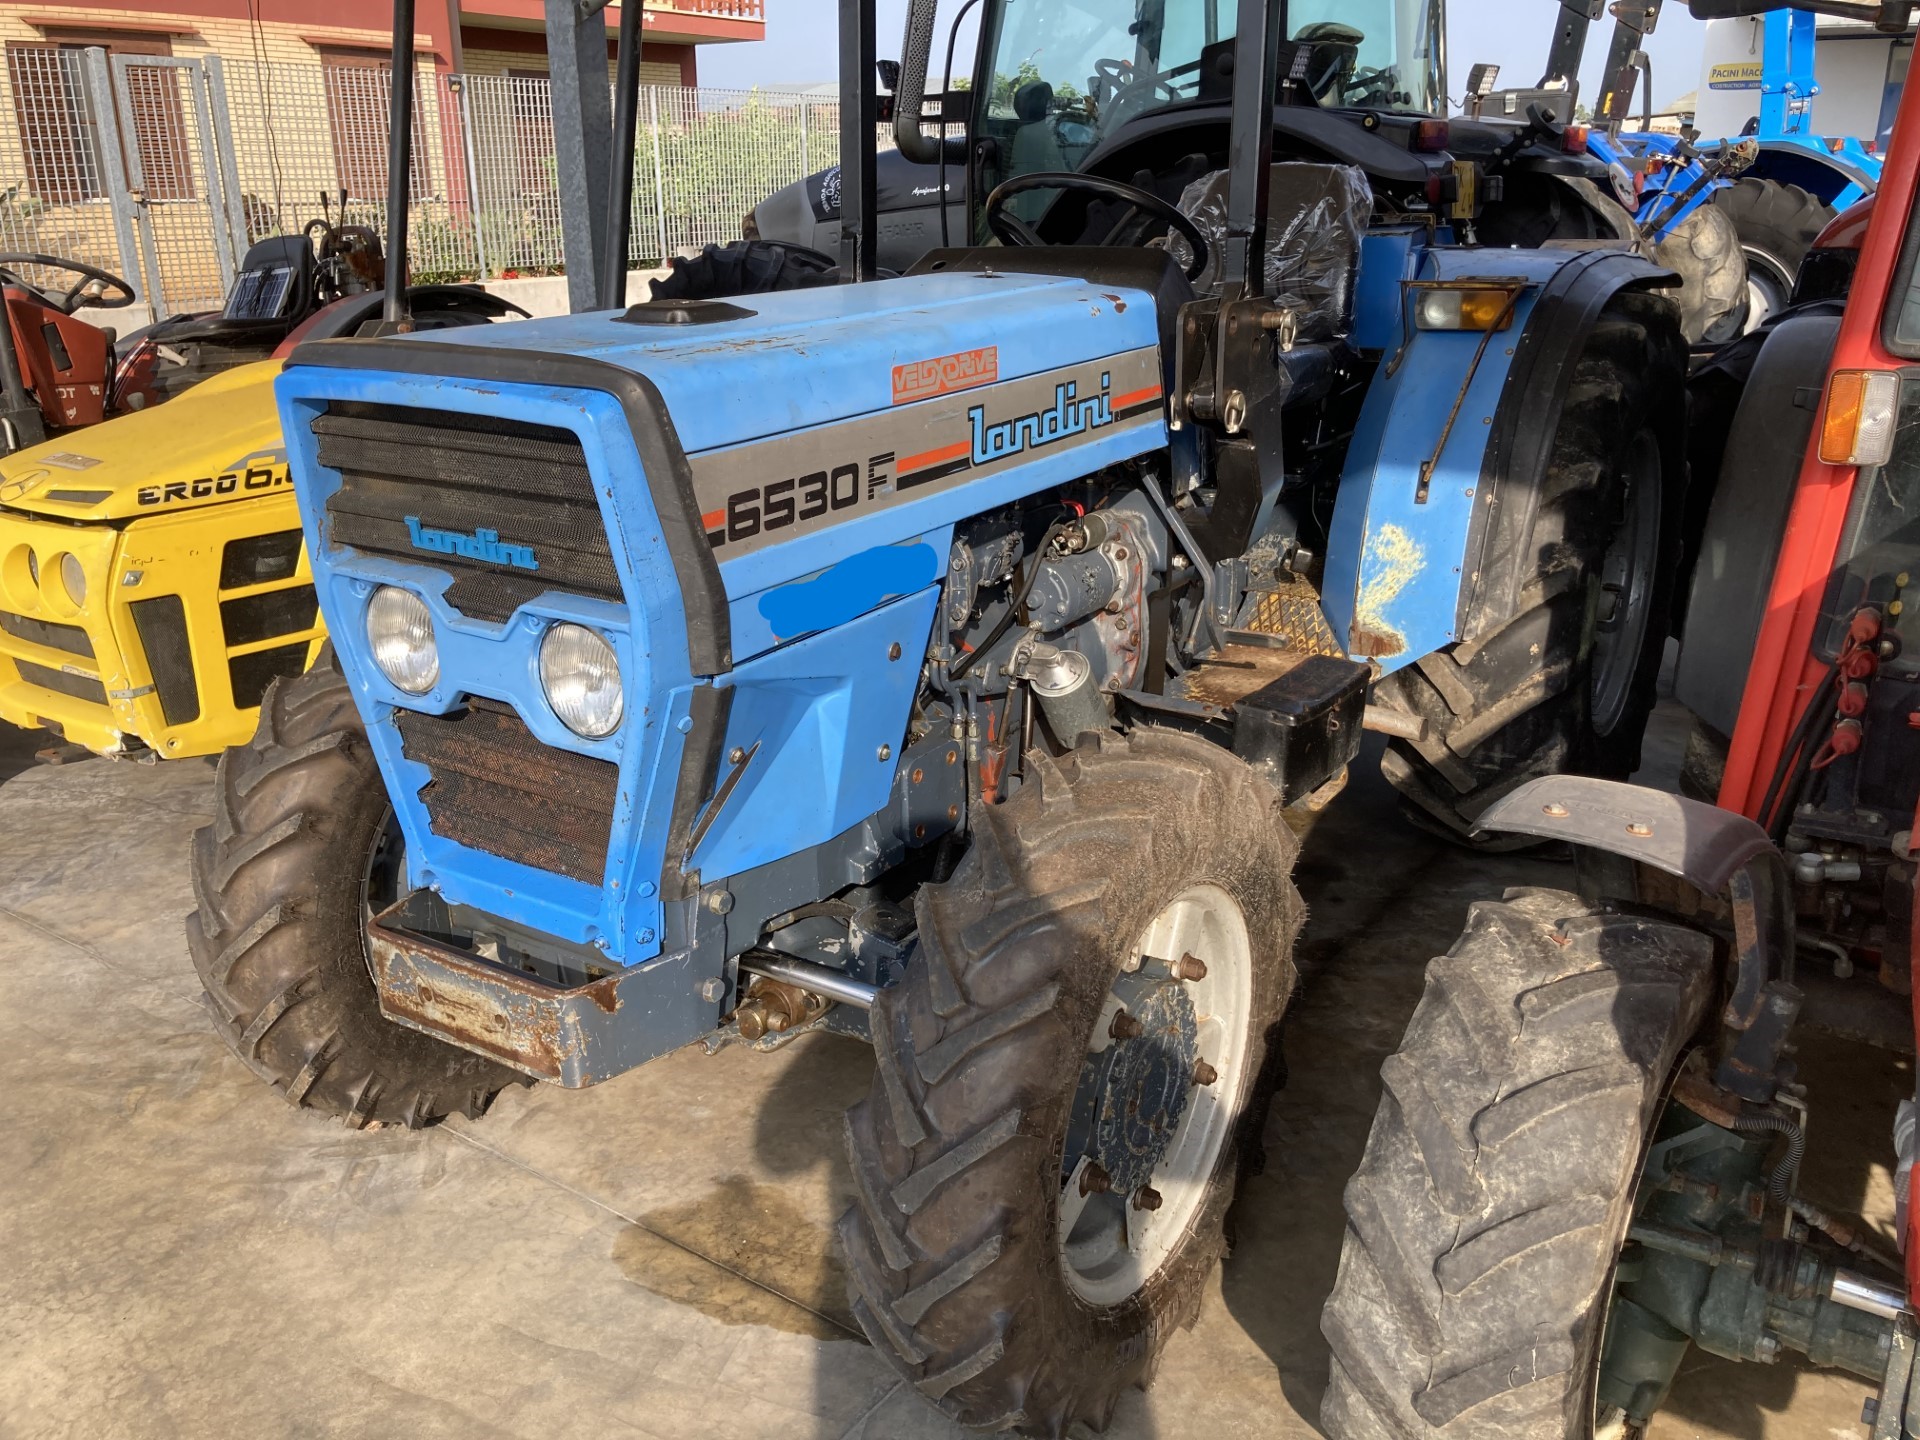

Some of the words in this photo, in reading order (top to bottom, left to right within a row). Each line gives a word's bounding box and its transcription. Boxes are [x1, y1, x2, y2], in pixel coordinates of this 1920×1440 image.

[1711, 68, 1739, 78] PACINI
[137, 474, 237, 506] ERGO
[728, 462, 859, 542] 6530
[868, 451, 895, 501] F
